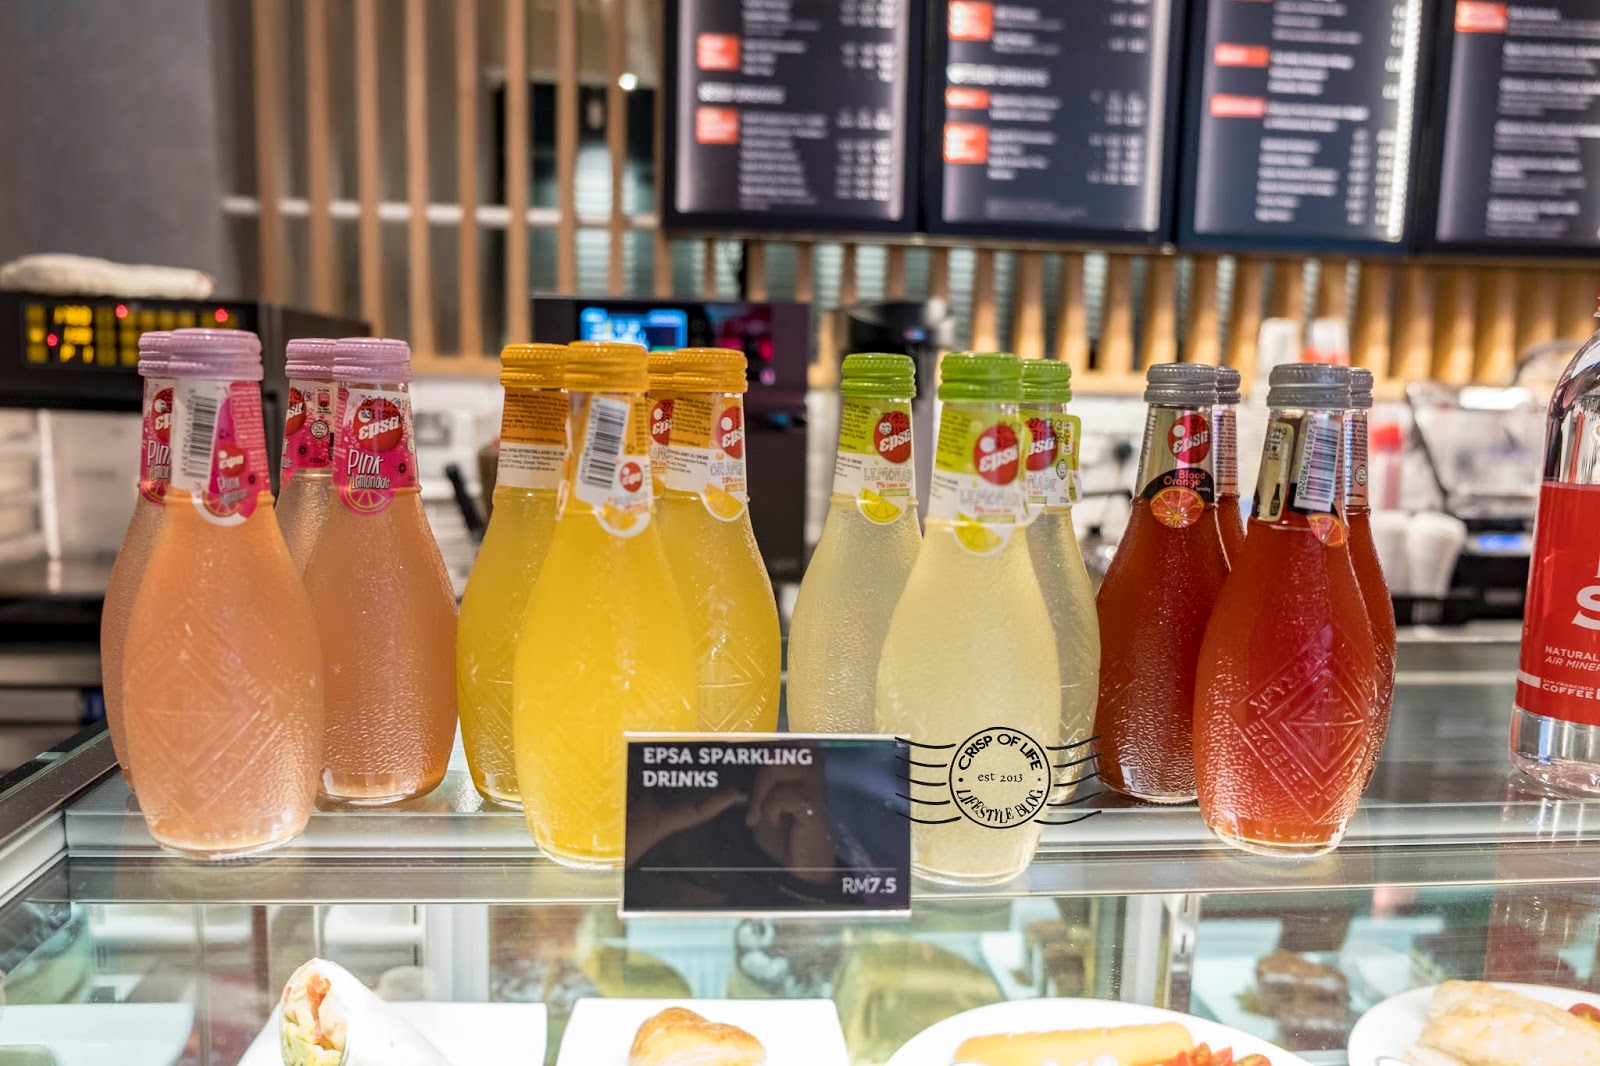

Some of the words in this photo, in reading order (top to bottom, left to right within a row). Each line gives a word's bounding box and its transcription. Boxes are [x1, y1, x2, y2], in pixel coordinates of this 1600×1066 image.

[347, 447, 384, 476] Pink
[1163, 476, 1202, 488] Orange
[1178, 469, 1206, 480] Blood
[1544, 645, 1600, 662] NATURAL
[1544, 655, 1564, 666] AIR
[1542, 683, 1594, 699] COFFEE
[643, 747, 694, 765] EPSA
[698, 747, 814, 766] SPARKLING
[642, 770, 719, 788] DRINKS
[841, 876, 898, 895] RM7.5
